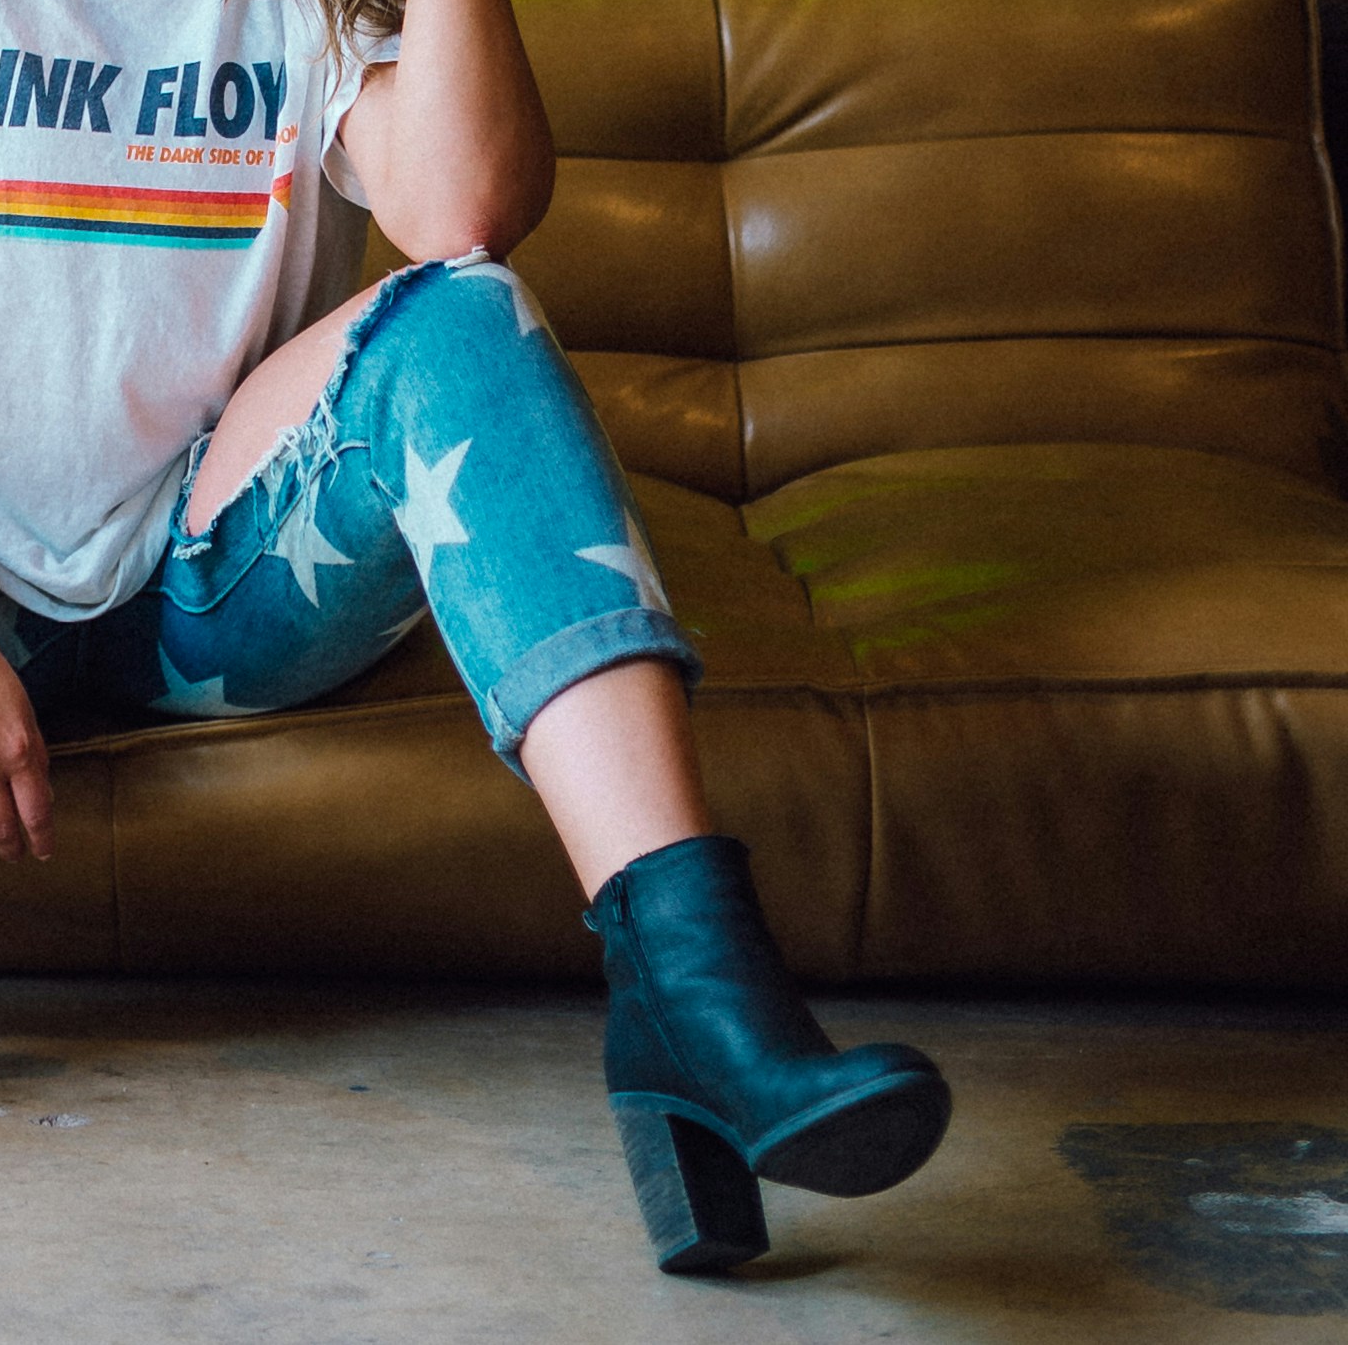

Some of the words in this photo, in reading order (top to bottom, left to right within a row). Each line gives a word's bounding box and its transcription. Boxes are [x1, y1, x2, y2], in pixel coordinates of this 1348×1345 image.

[126, 145, 155, 162] THE
[159, 147, 205, 164] DARK
[208, 148, 241, 165] SIDE
[245, 149, 264, 166] OF
